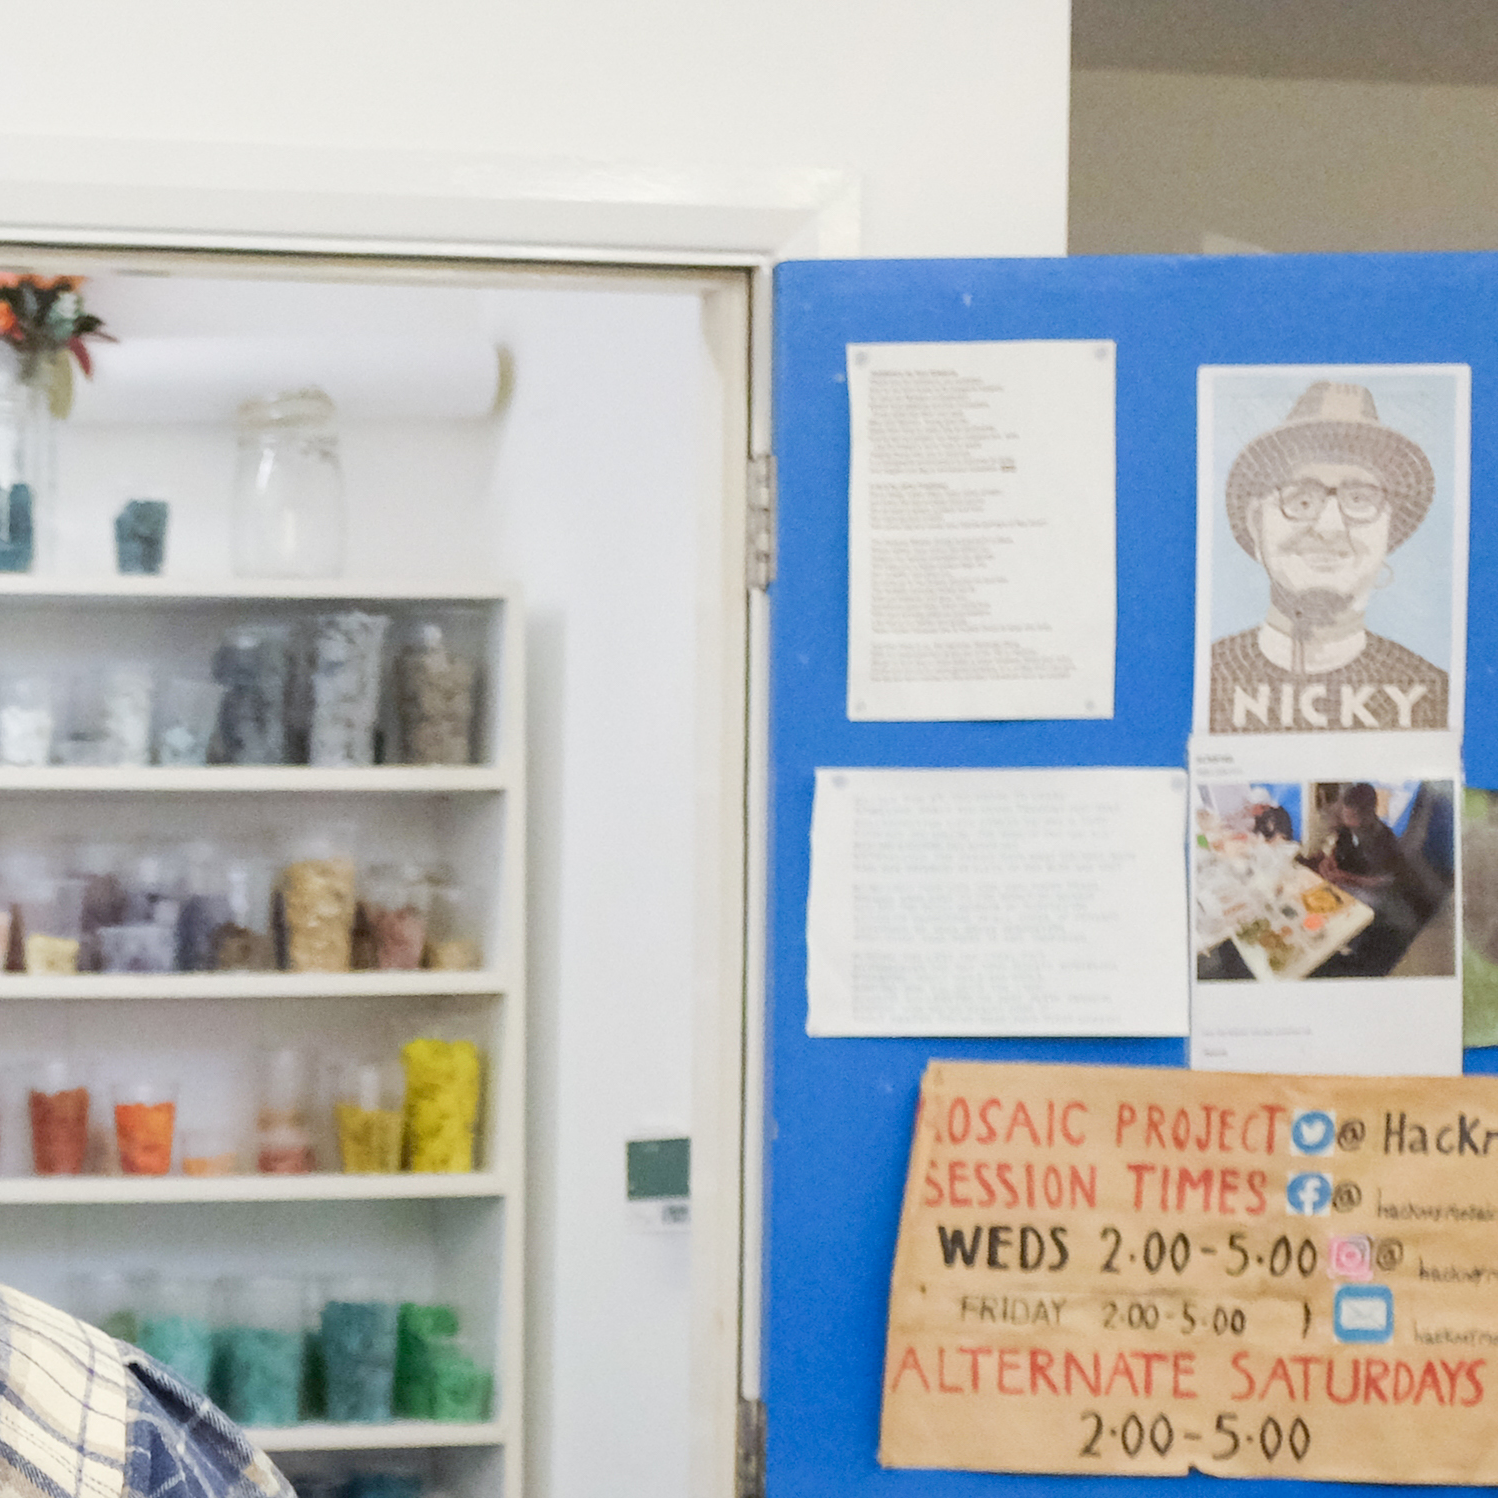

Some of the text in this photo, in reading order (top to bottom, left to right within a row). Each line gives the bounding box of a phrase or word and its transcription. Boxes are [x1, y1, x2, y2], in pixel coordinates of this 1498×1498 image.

[1232, 682, 1428, 728] NICKY
[934, 1096, 1288, 1156] OSAIC PROJECT
[924, 1160, 1269, 1217] SESSION TIMES
[937, 1224, 1070, 1273] WEDS
[960, 1295, 1068, 1325] FRIDAY
[890, 1346, 1486, 1407] ALTERNATE SATURDAYS
